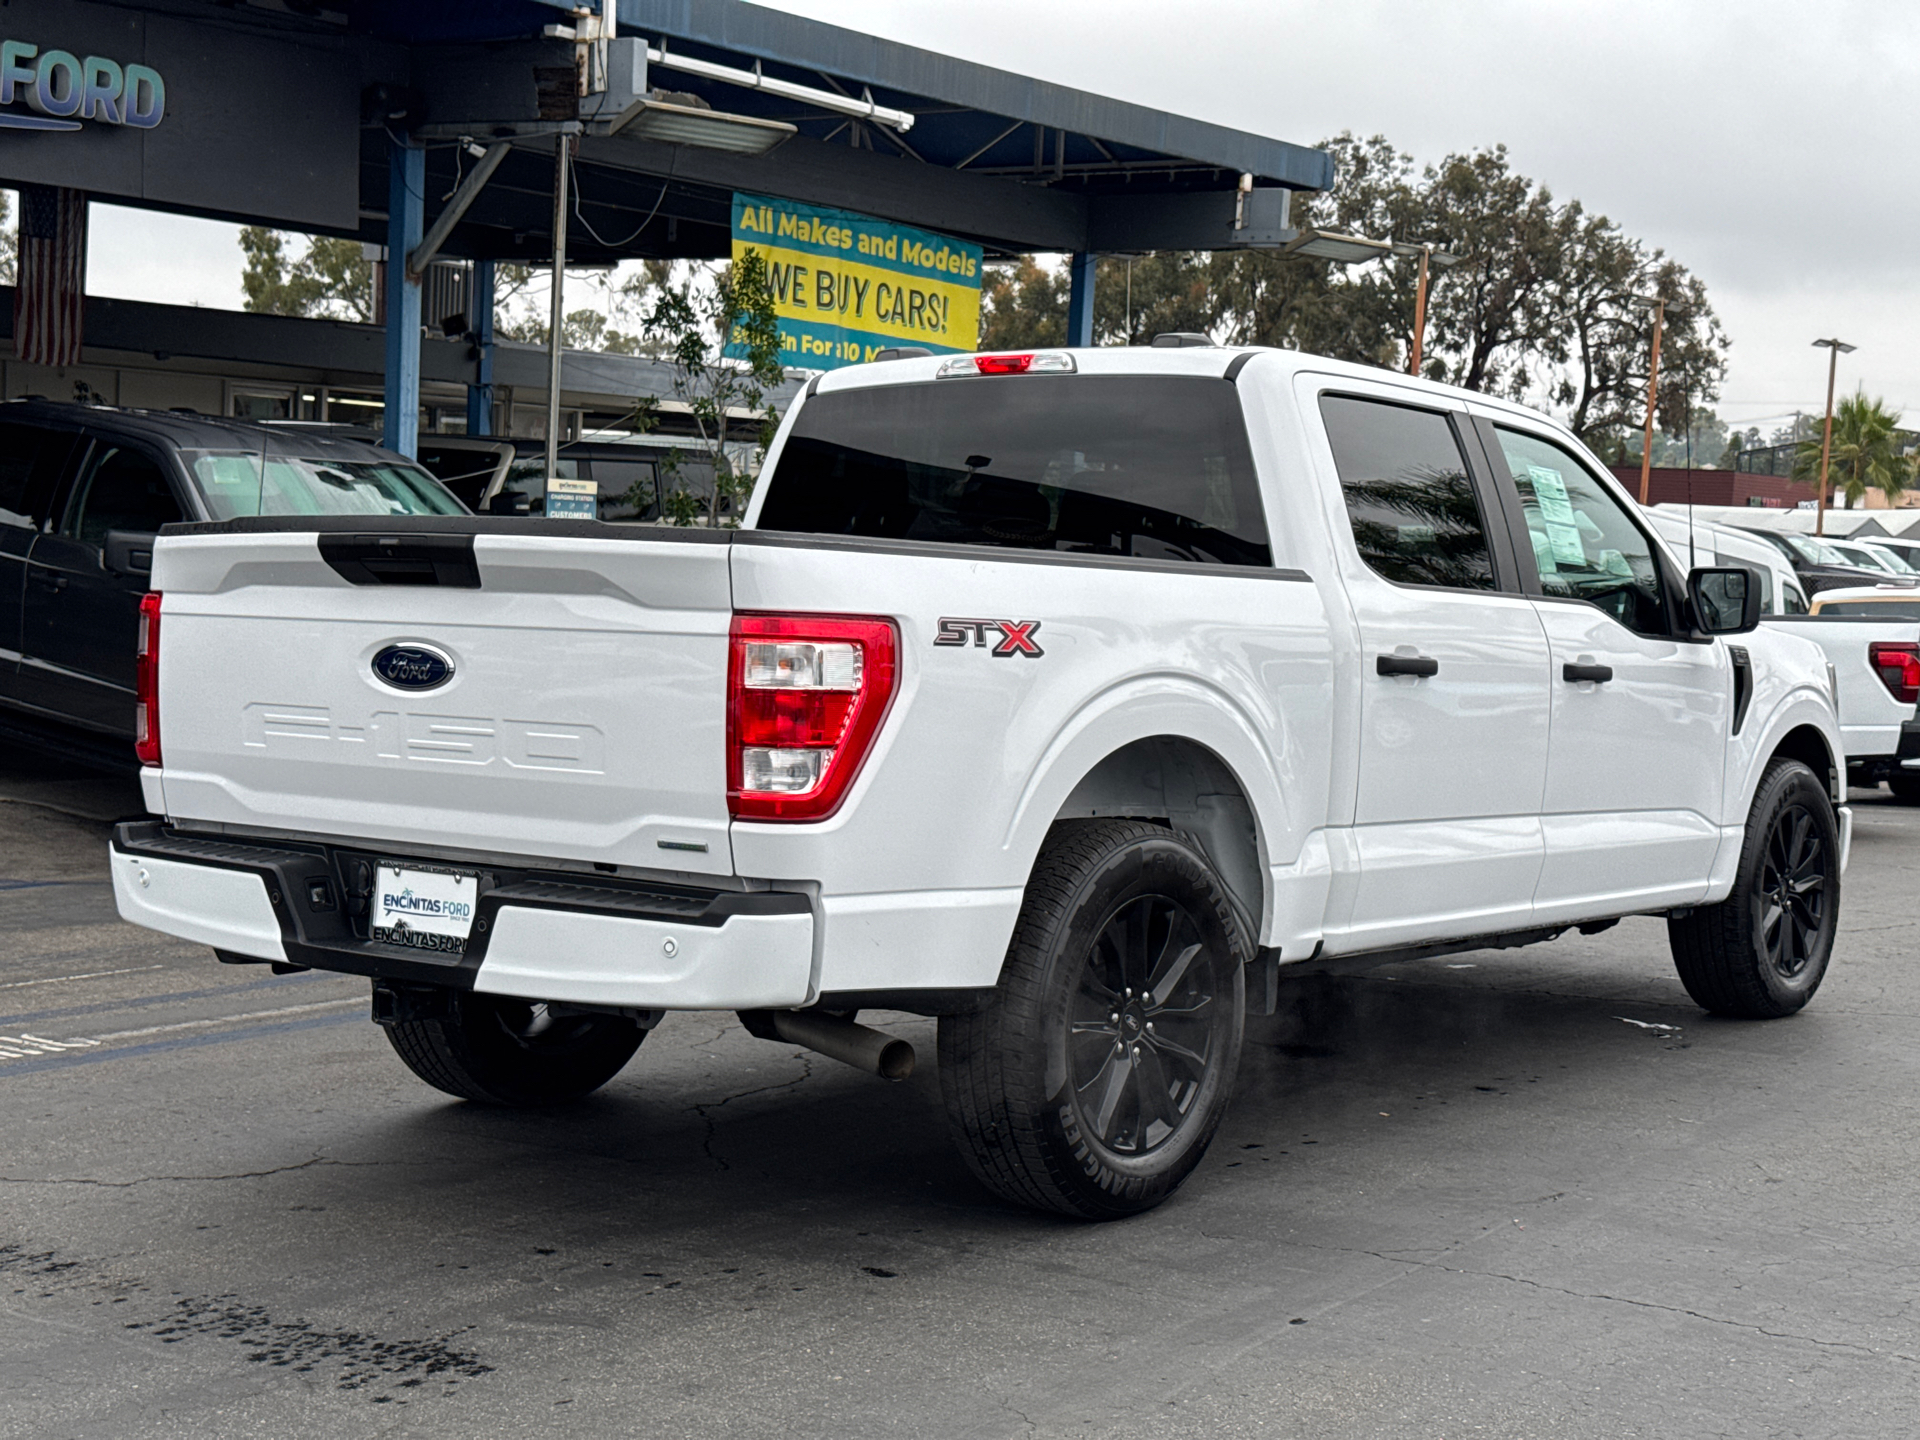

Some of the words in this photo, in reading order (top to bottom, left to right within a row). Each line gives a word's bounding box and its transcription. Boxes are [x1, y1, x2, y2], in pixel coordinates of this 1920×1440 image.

[0, 39, 165, 129] FORD
[740, 204, 774, 234] All
[777, 211, 853, 249] Makes
[858, 232, 897, 260] and
[902, 239, 976, 277] Models
[764, 260, 808, 308] WE
[816, 269, 871, 318] BUY
[875, 282, 950, 333] CARS!
[801, 334, 834, 356] For
[843, 341, 860, 362] 10
[549, 510, 593, 519] CUSTOMERS
[933, 616, 1045, 659] STX
[387, 651, 433, 681] Ford
[243, 701, 605, 776] F-150
[383, 892, 441, 913] ENCINITAS
[442, 900, 470, 917] FORD
[1151, 852, 1240, 956] GOODYEAR
[373, 927, 438, 948] ENCINITAS
